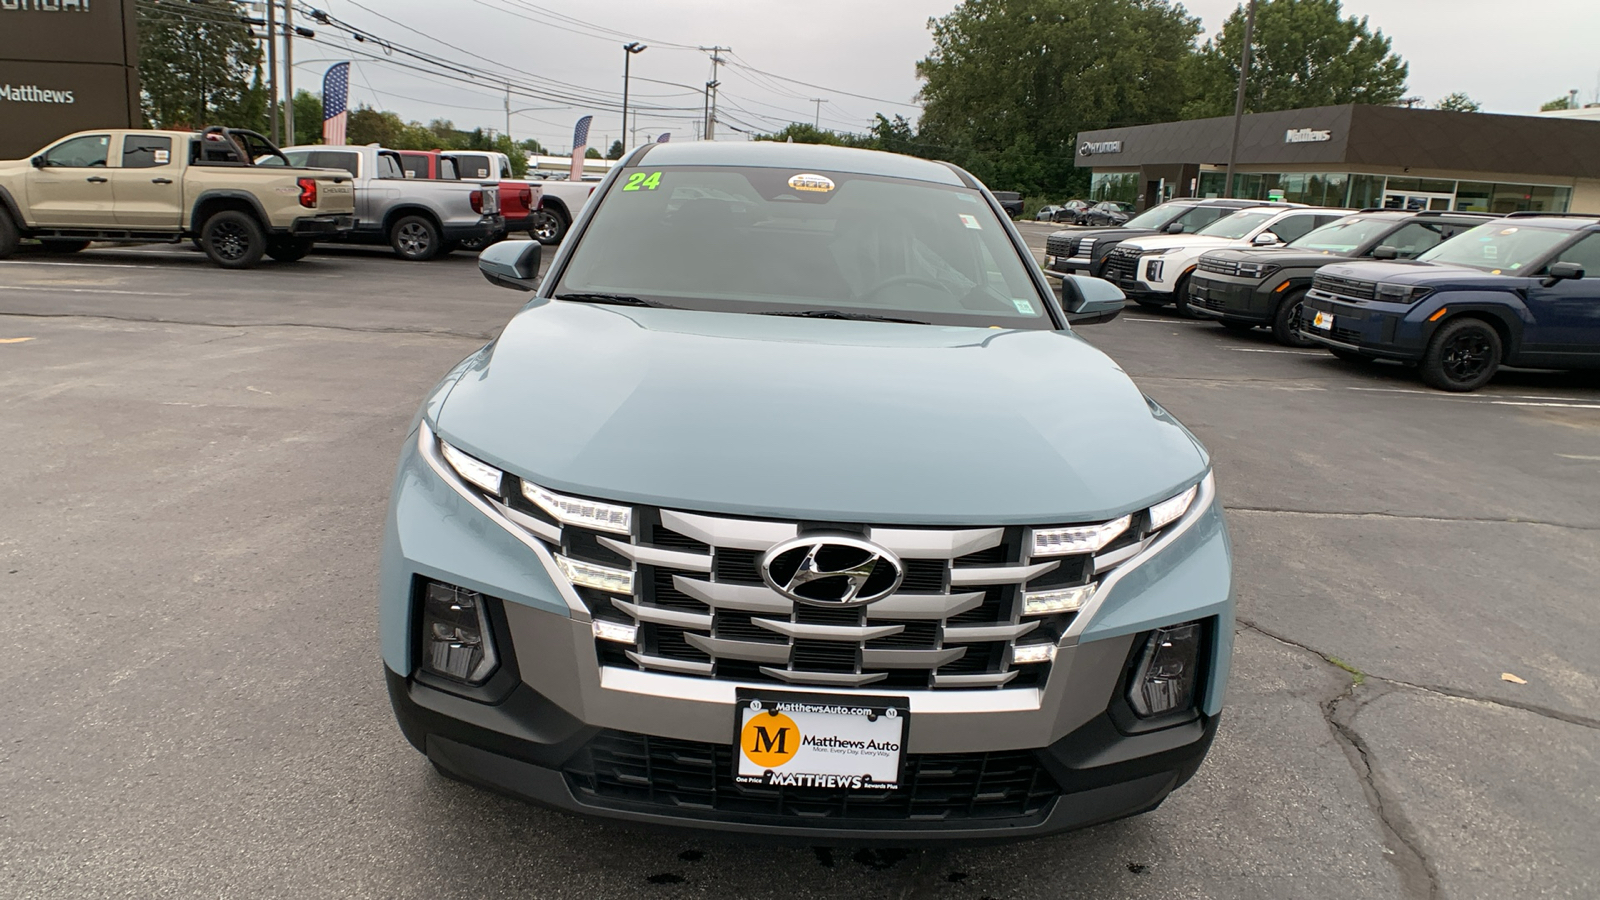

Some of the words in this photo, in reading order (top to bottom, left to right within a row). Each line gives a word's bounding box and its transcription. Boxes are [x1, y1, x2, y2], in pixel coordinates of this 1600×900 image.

[0, 84, 75, 104] Matthews
[1285, 128, 1331, 143] Matthews
[1090, 141, 1121, 154] HYUNDAI
[622, 171, 662, 191] 24
[775, 702, 872, 716] MatthewsAuto.com
[750, 725, 791, 754] M
[802, 734, 865, 750] Matthews
[866, 739, 899, 752] Auto
[768, 772, 862, 790] MATTHEWS
